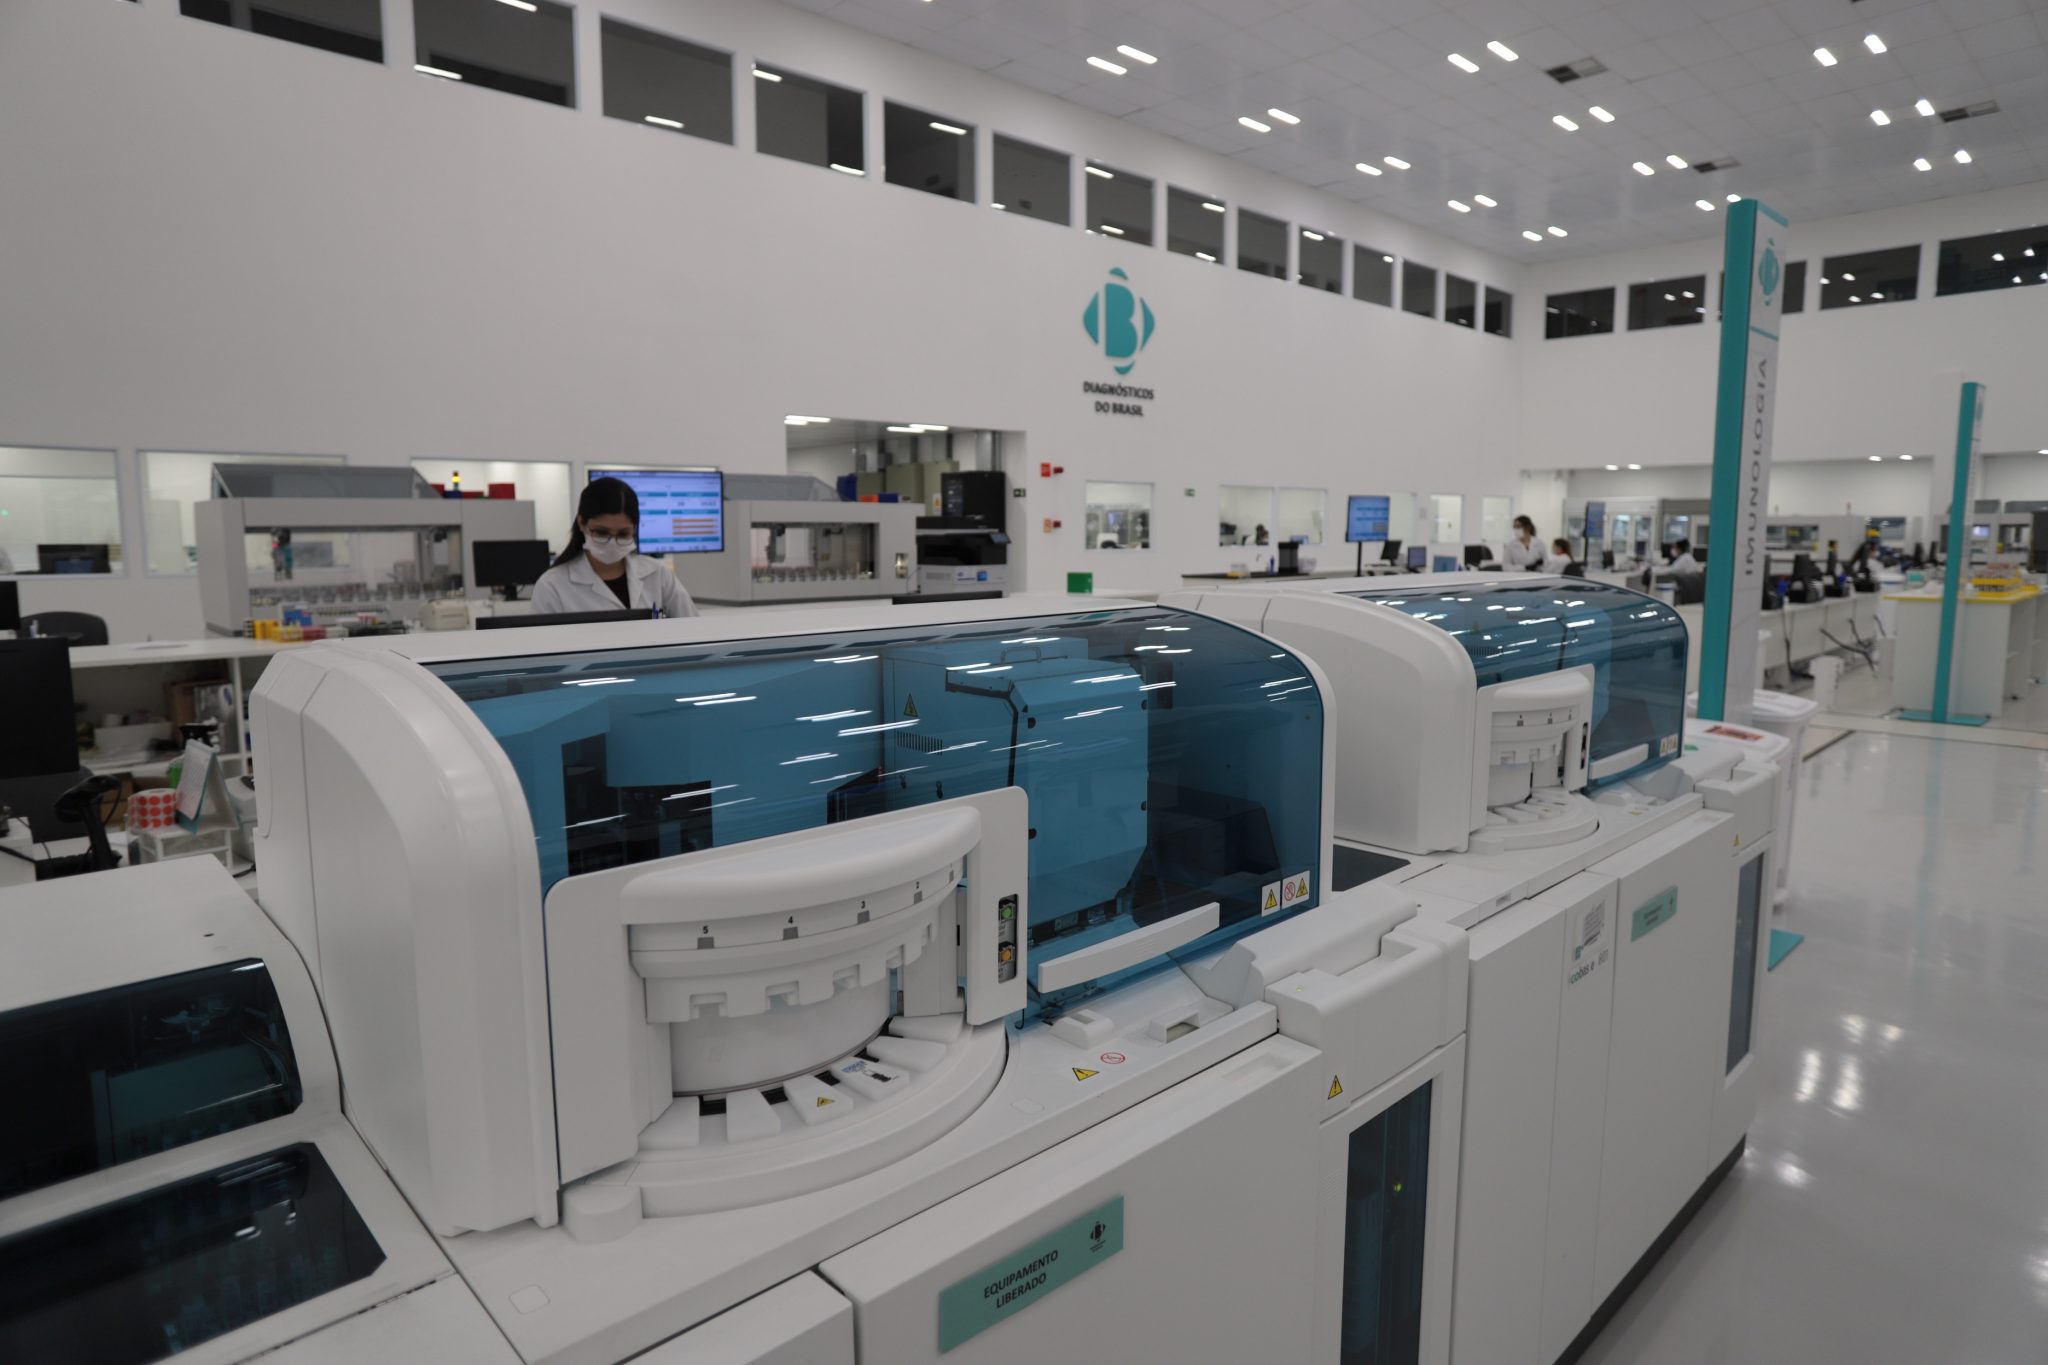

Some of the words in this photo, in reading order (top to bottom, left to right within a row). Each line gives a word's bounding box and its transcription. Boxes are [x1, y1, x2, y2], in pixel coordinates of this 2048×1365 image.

[1083, 381, 1154, 400] DIAGNÓSTICOS
[1095, 401, 1110, 413] DO
[1112, 402, 1143, 416] BRASIL
[1745, 358, 1767, 576] IMUNOLOGIA
[787, 915, 794, 924] 4
[702, 925, 709, 934] 5
[983, 1250, 1059, 1299] EQUIPAMENTO
[996, 1272, 1047, 1309] LIBERADO
